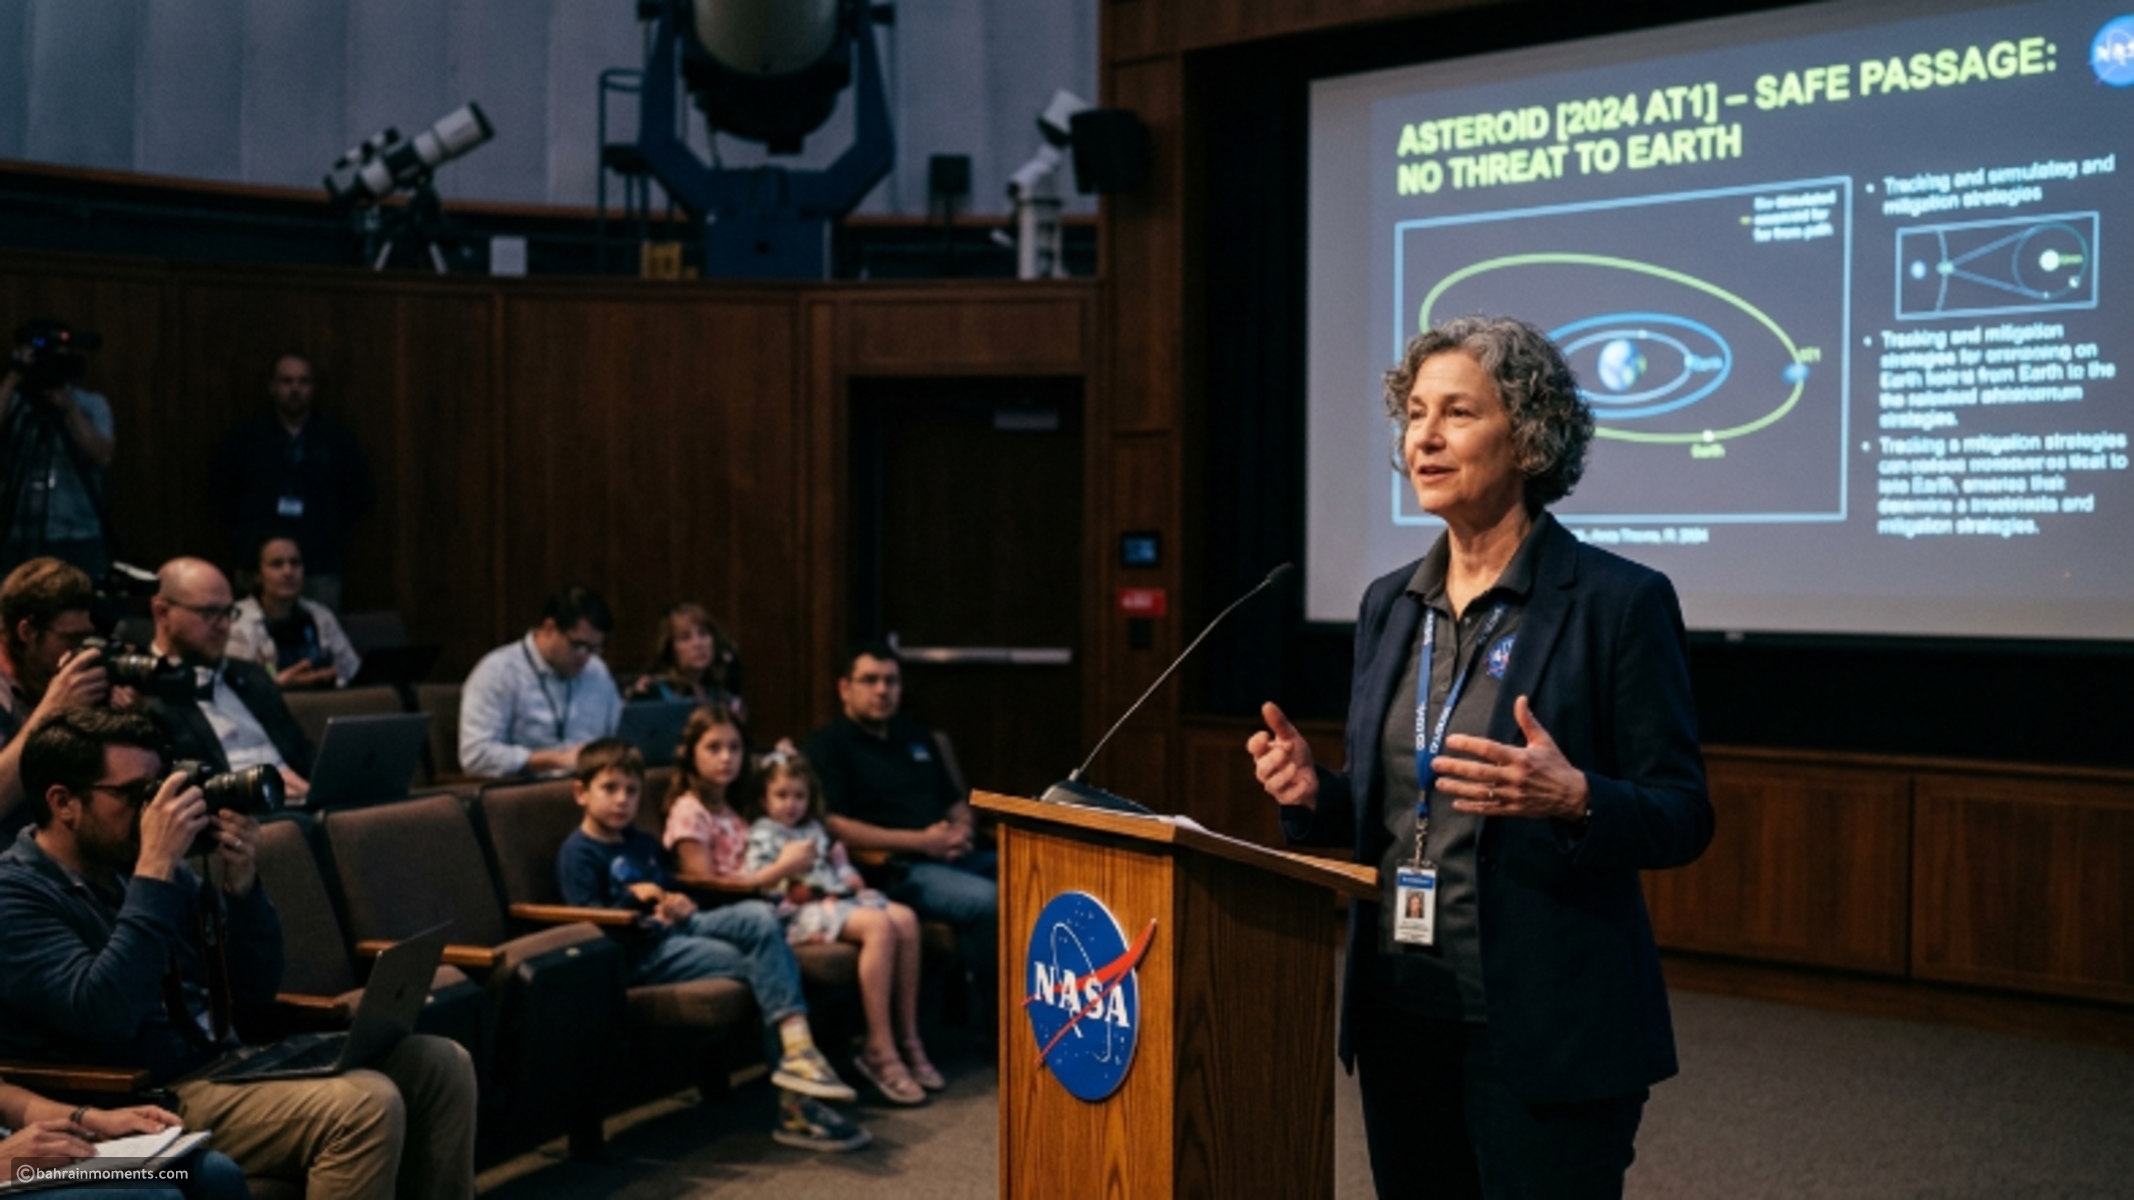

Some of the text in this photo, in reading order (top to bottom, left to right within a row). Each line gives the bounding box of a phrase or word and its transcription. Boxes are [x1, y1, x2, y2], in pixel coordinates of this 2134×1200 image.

[1397, 105, 1550, 157] ASTEROID
[1556, 93, 1639, 143] [2024
[1644, 82, 1718, 125] AT1]
[1754, 64, 1850, 110] SAFE
[1859, 37, 2057, 96] PASSAGE:
[1397, 122, 1743, 196] NO THREAT TO EARTH
[1954, 168, 1985, 188] and
[2082, 153, 2116, 175] and
[2018, 362, 2064, 383] Earth
[2087, 360, 2117, 379] the
[1034, 961, 1130, 1028] NASA
